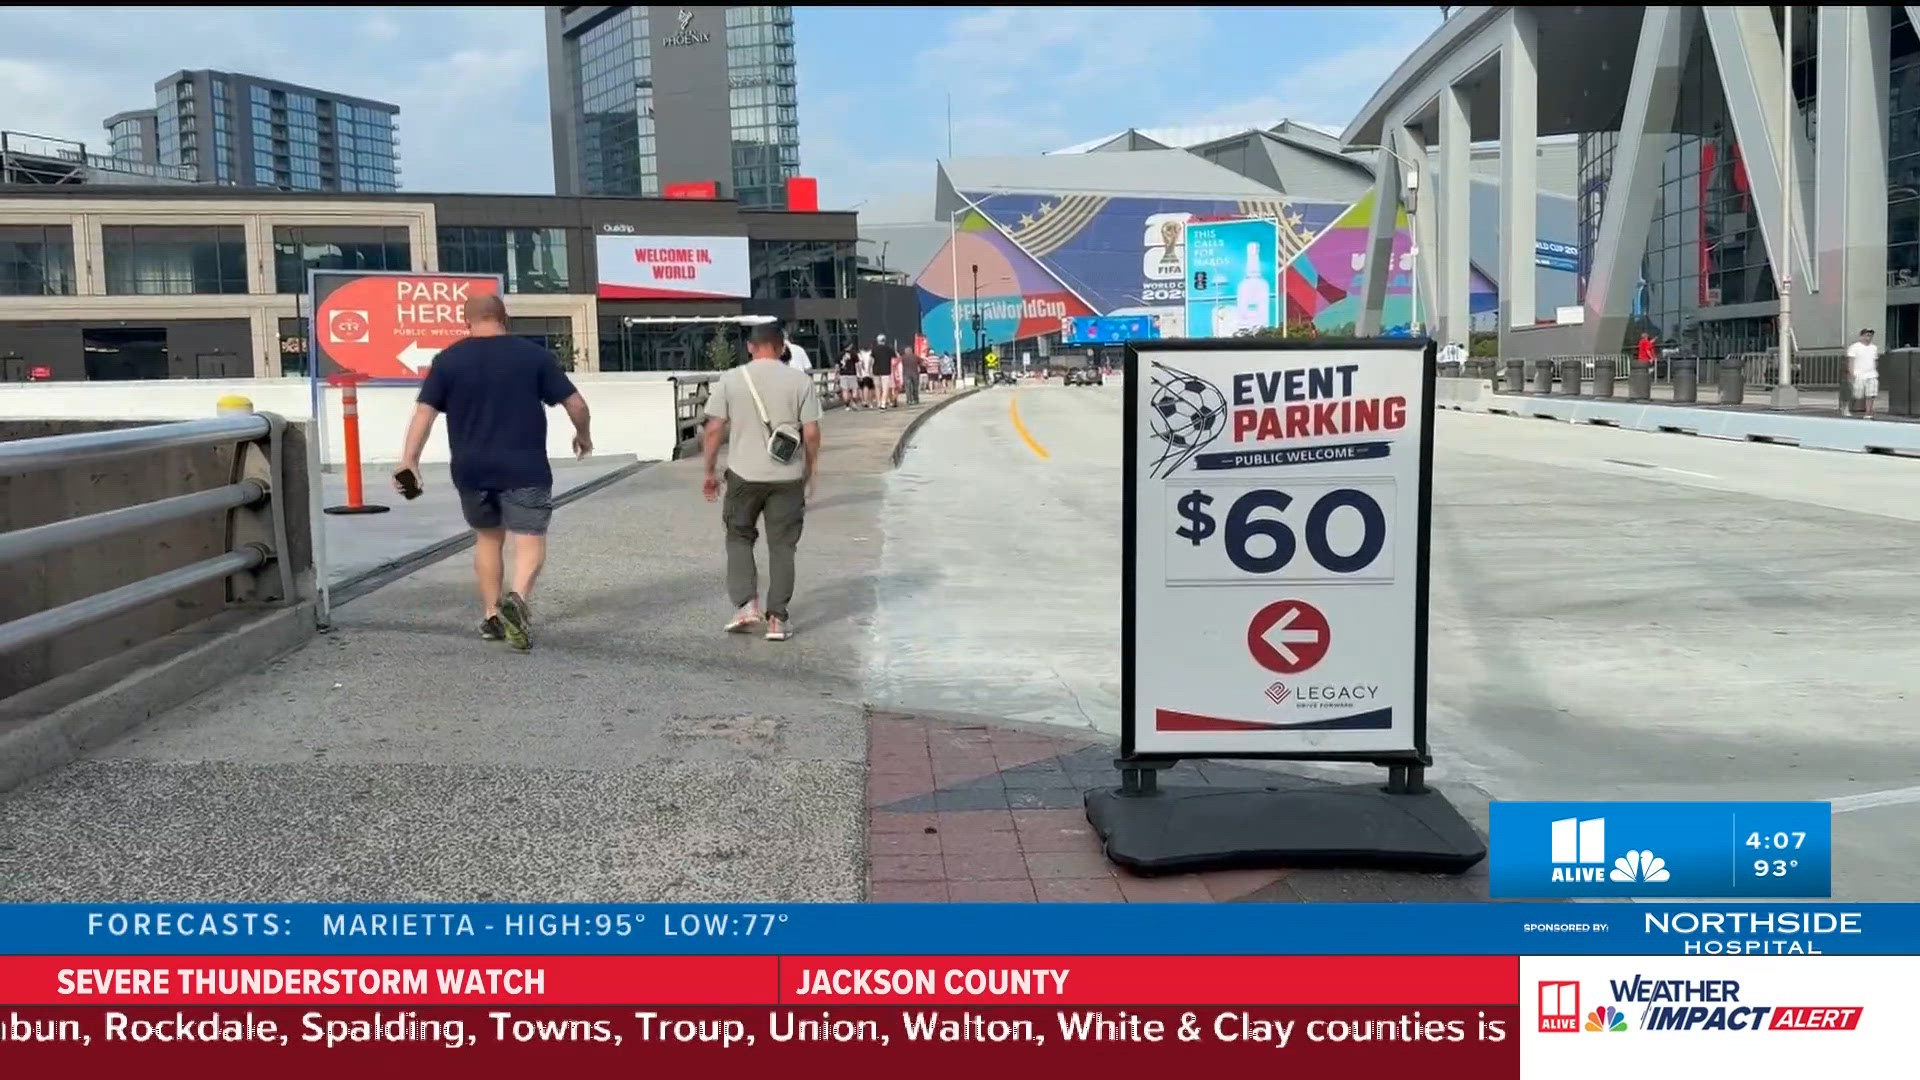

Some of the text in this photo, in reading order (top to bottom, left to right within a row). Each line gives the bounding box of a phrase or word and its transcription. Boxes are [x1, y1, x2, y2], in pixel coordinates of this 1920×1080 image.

[662, 33, 710, 47] PHOENIX
[1193, 229, 1217, 239] THIS
[1193, 239, 1225, 248] CALLS
[634, 248, 712, 265] WELCOME IN,
[652, 265, 696, 280] WORLD
[1157, 265, 1182, 275] FIFA
[397, 281, 470, 302] PARK
[1142, 282, 1176, 290] WORLD
[397, 304, 465, 324] HERE
[393, 328, 427, 336] PUBLIC
[430, 329, 471, 337] WELCOM
[1233, 364, 1359, 406] EVENT
[1233, 395, 1407, 443] PARKING
[1234, 447, 1355, 466] PUBLIC WELCOME
[1175, 488, 1387, 574] $60
[1296, 686, 1379, 700] LEGACY
